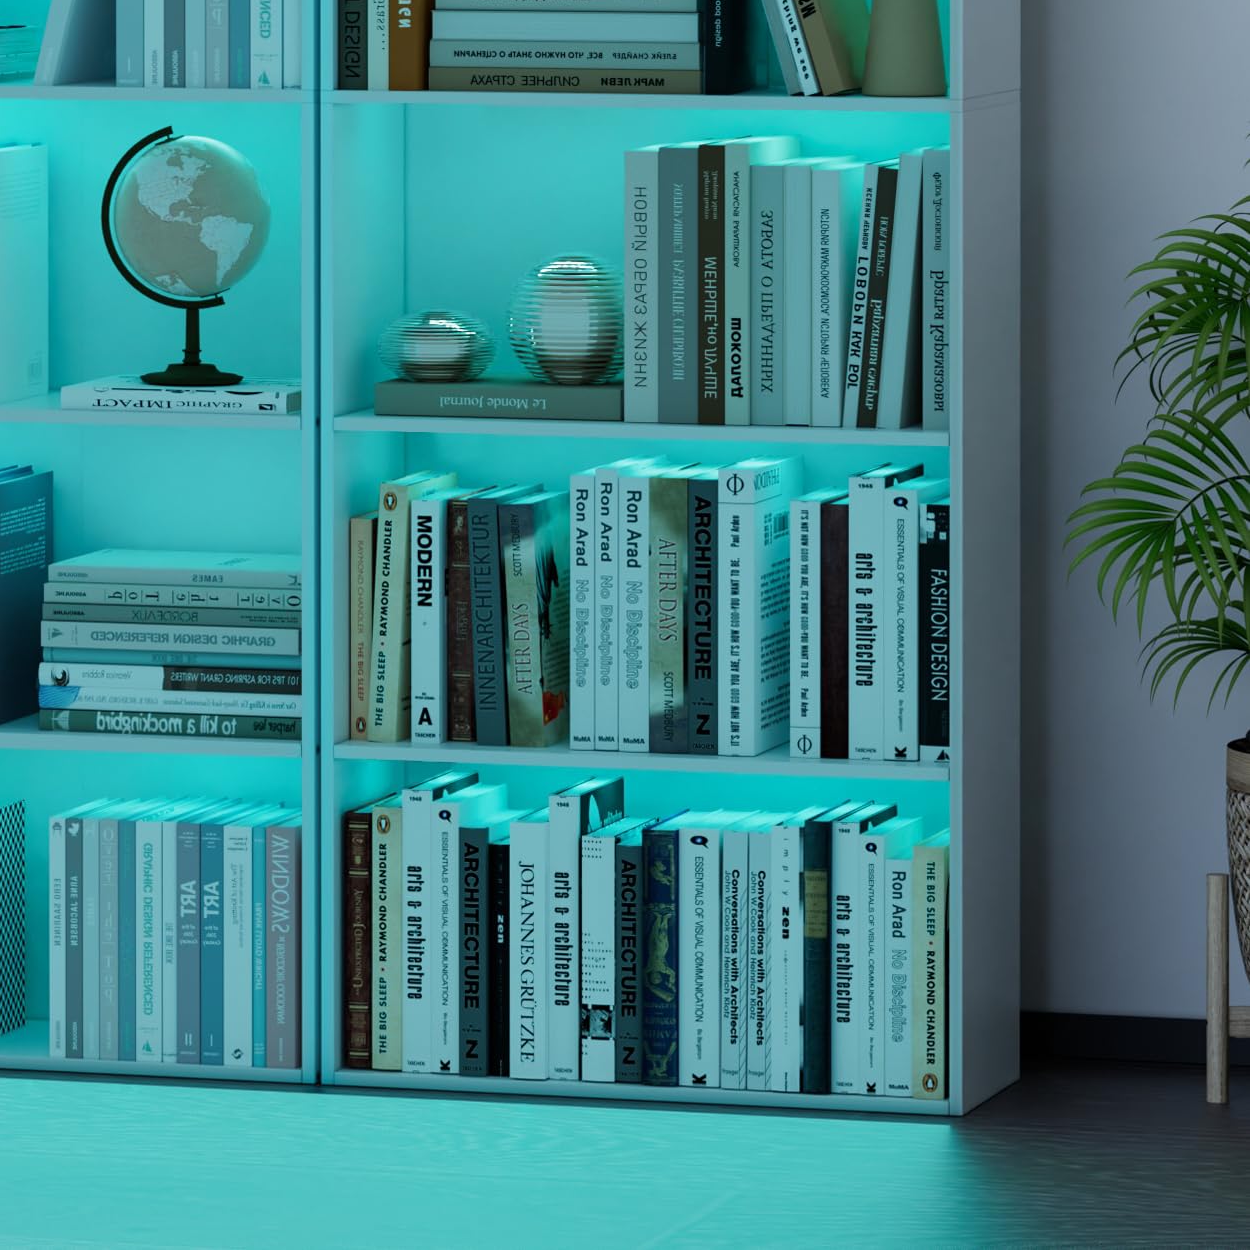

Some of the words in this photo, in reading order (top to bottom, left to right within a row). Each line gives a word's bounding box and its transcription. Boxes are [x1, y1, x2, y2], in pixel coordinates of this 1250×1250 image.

[92, 399, 172, 409] IMPACT
[440, 396, 484, 409] Journal
[487, 397, 529, 409] Monde
[533, 399, 546, 409] Le
[576, 489, 589, 521] Ron
[600, 483, 612, 516] Ron
[626, 490, 642, 524] Ron
[382, 520, 392, 577] CHANDLER
[576, 528, 589, 567] Arad
[600, 523, 612, 562] Arad
[626, 530, 642, 568] Arad
[897, 519, 905, 571] ESSENTIALS
[417, 516, 432, 607] MODERN
[513, 553, 523, 577] SCOTT
[855, 552, 877, 580] arts
[897, 573, 905, 582] OF
[626, 581, 642, 604] No
[694, 496, 712, 680] ARCHITECTURE
[897, 584, 905, 616] VISUAL
[930, 569, 948, 637] FASHION
[379, 580, 390, 637] RAYMOND
[472, 513, 497, 711] INNENARCHITEKTUR
[512, 604, 530, 641] DAYS
[623, 610, 643, 689] Discipline
[855, 603, 878, 687] architecture
[897, 618, 905, 693] COMMUNICATION
[377, 651, 386, 680] SLEEP
[515, 647, 533, 695] AFTER
[930, 642, 948, 701] DESIGN
[376, 683, 384, 703] BIG
[375, 707, 384, 727] THE
[418, 707, 432, 725] A
[379, 843, 387, 901] CHANDLER
[407, 866, 425, 892] arts
[554, 872, 572, 899] arts
[695, 856, 704, 906] ESSENTIALS
[892, 871, 906, 899] Ron
[927, 862, 935, 881] THE
[731, 869, 740, 954] Conversations
[757, 870, 766, 955] Conversations
[836, 895, 852, 920] arts
[927, 885, 935, 903] BIG
[464, 842, 480, 1009] ARCHITECTURE
[518, 861, 535, 965] JOHANNES
[695, 907, 704, 919] OF
[782, 907, 790, 939] zen
[892, 904, 906, 938] Arad
[927, 907, 935, 936] SLEEP
[379, 905, 387, 962] RAYMOND
[621, 859, 637, 1018] ARCHITECTURE
[695, 920, 704, 949] VISUAL
[407, 917, 426, 1000] architecture
[554, 922, 573, 1007] architecture
[731, 958, 739, 982] with
[757, 959, 765, 983] with
[379, 977, 387, 1007] SLEEP
[695, 951, 704, 1022] COMMUNICATION
[836, 943, 853, 1023] architecture
[927, 951, 935, 1005] RAYMOND
[379, 1011, 387, 1031] BIG
[520, 970, 537, 1063] GRÜTZKE
[730, 985, 738, 1045] Architects
[756, 987, 765, 1046] Architects
[379, 1034, 387, 1054] THE
[927, 1010, 935, 1065] CHANDLER
